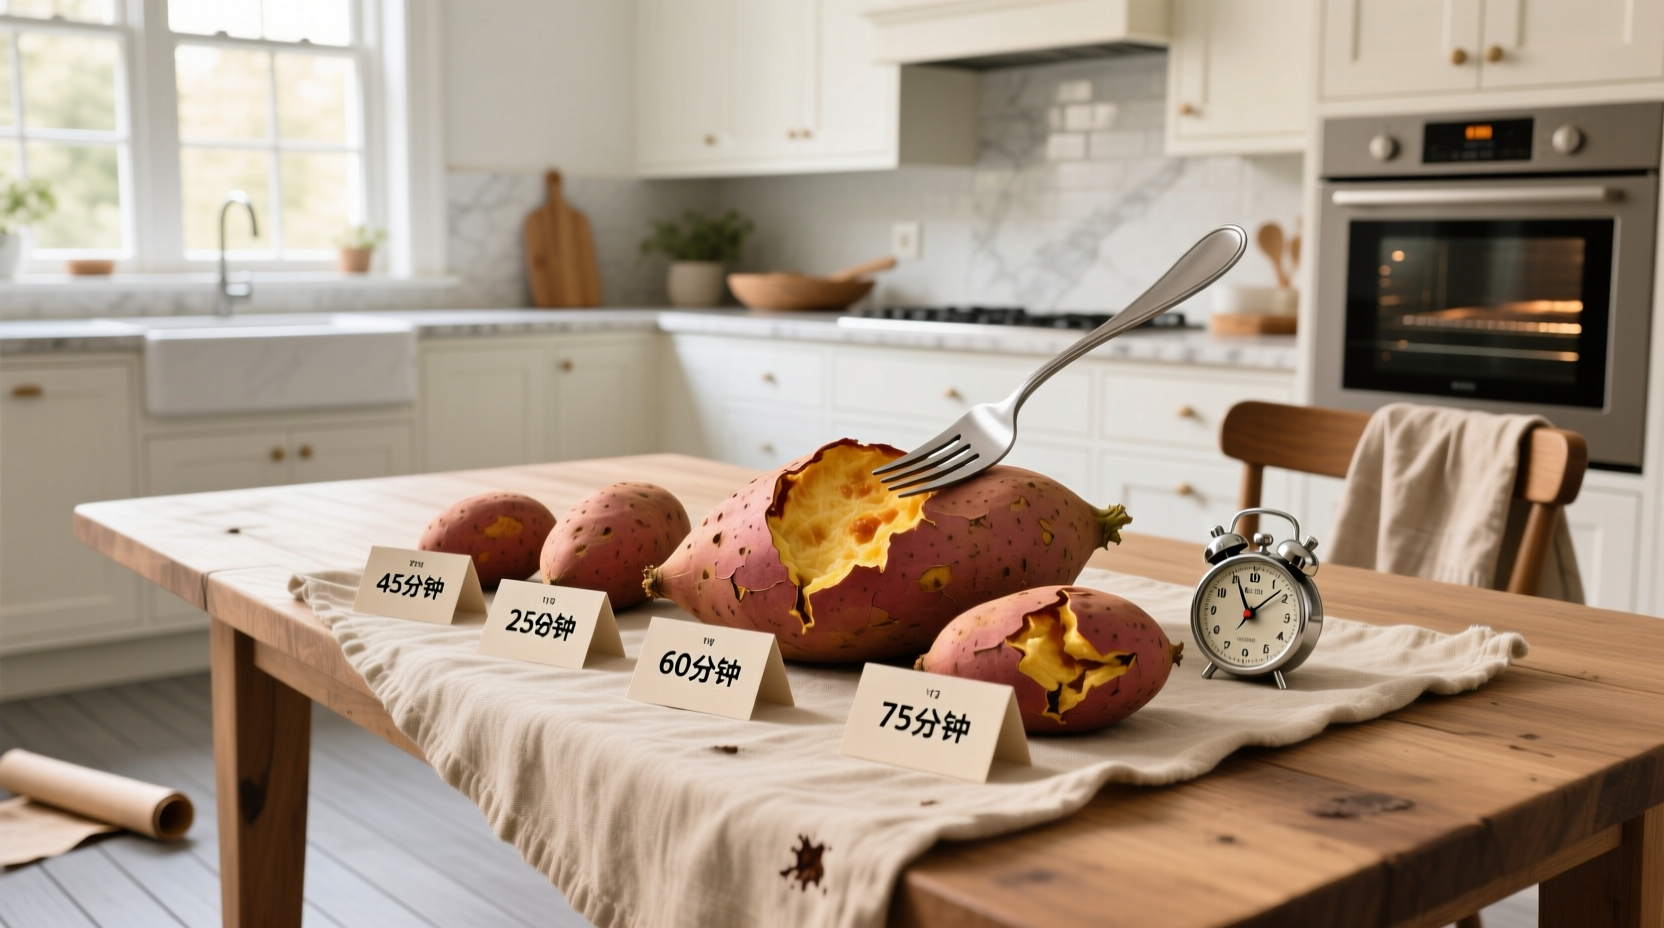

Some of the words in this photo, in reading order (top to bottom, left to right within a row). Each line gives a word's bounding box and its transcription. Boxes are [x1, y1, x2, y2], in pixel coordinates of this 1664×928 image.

[376, 573, 445, 600] 45分钟
[659, 650, 741, 687] 60分钟
[879, 701, 971, 744] 75分钟
